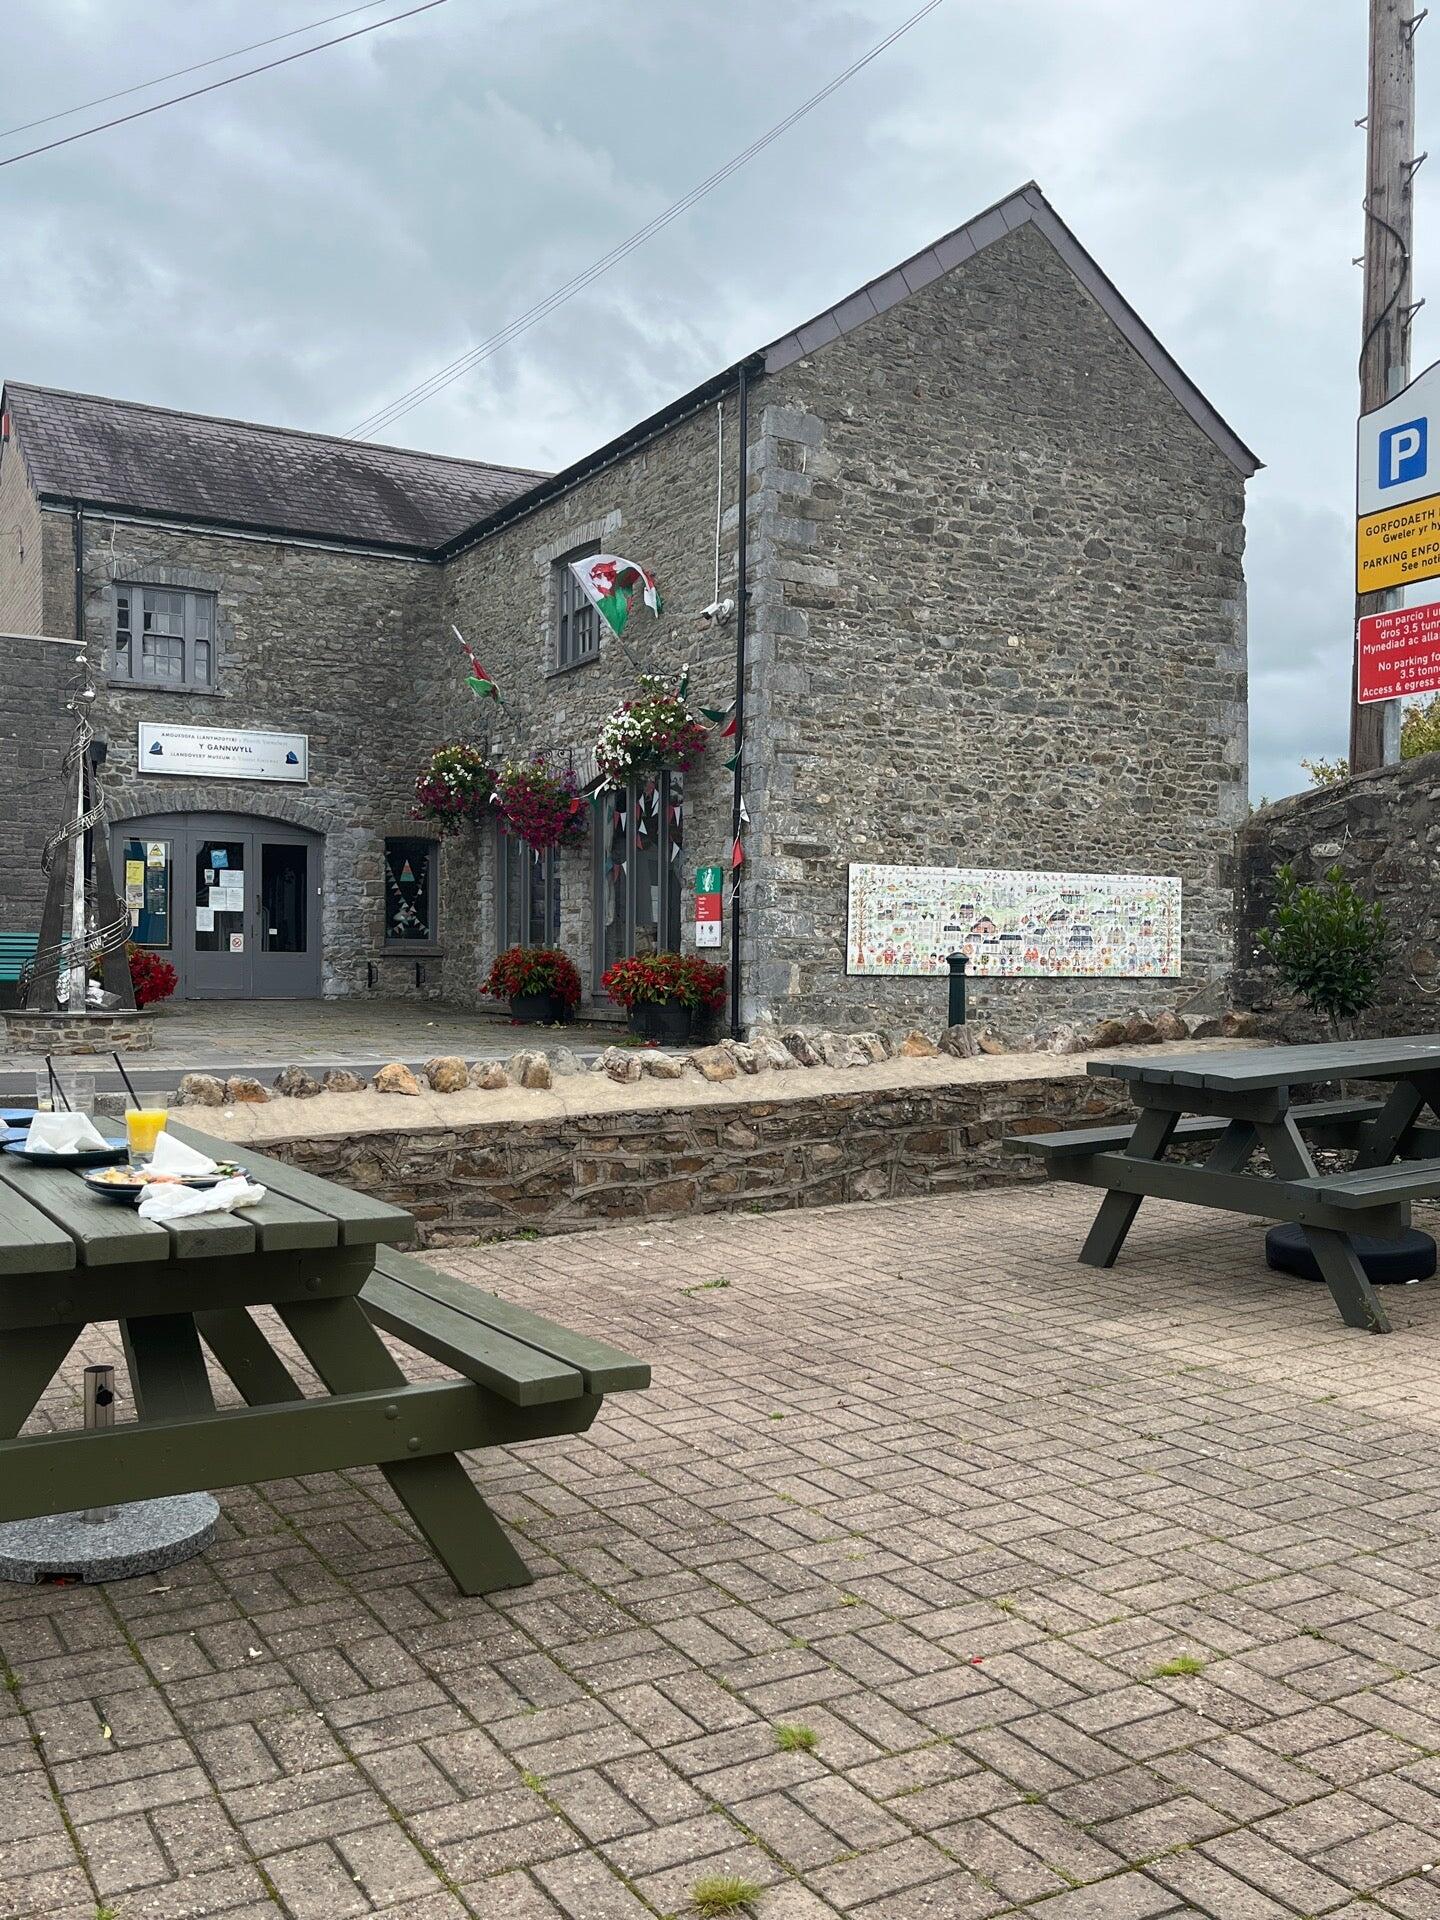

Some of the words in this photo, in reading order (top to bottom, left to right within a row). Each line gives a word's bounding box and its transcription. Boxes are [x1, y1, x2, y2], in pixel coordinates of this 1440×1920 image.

[1389, 428, 1420, 481] P
[1366, 509, 1435, 536] GORFODAETH
[1383, 529, 1415, 543] Gweler
[1419, 525, 1428, 535] yr
[1363, 551, 1407, 570] PARKING
[1401, 562, 1418, 572] See
[1375, 619, 1392, 629] Dim
[1395, 611, 1424, 626] parcio
[1380, 629, 1400, 639] dros
[1403, 623, 1418, 635] 3.5
[1363, 637, 1405, 655] Mynediad
[1408, 636, 1419, 645] ac
[1378, 661, 1391, 671] No
[1394, 655, 1428, 670] parking
[1400, 667, 1415, 679] 3.5
[1418, 665, 1440, 676] tonn
[1362, 685, 1393, 698] Access
[1395, 682, 1402, 691] &
[1404, 677, 1435, 691] egress
[207, 743, 252, 753] GANNWYLL
